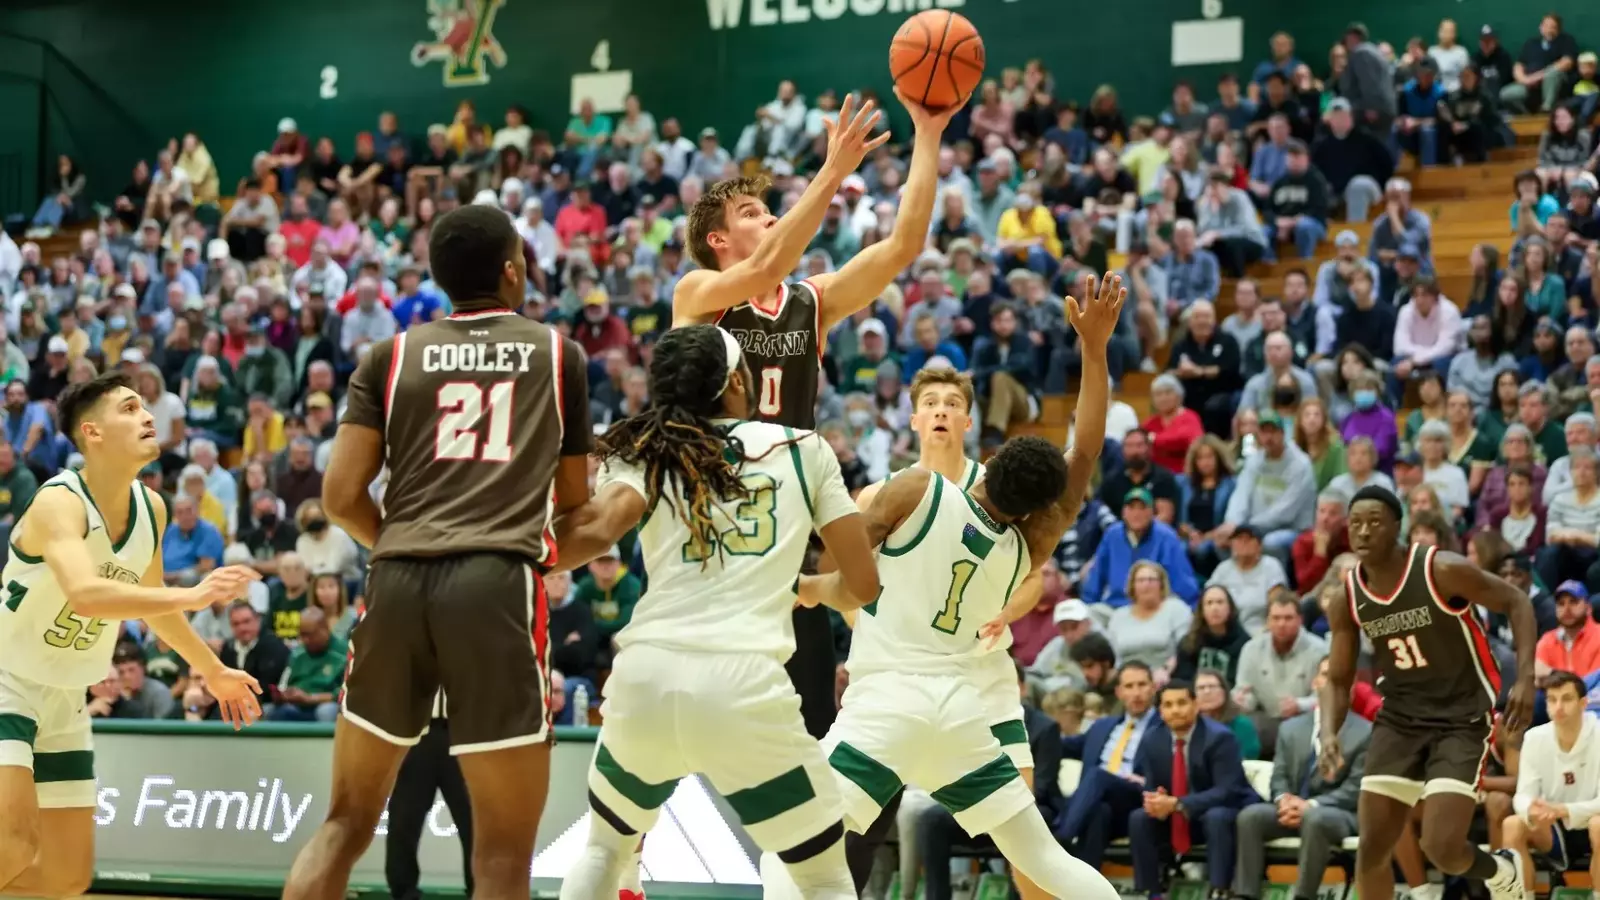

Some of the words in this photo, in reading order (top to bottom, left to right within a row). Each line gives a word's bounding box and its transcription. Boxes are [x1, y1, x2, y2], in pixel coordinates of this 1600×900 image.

[706, 0, 966, 30] WELC
[590, 39, 612, 71] 4
[320, 65, 338, 99] 2
[422, 341, 537, 373] COOLEY
[758, 366, 783, 417] 0
[433, 379, 516, 462] 21
[931, 558, 979, 635] 1
[43, 600, 108, 651] 55
[1361, 605, 1432, 640] BROWN
[1387, 634, 1429, 671] 31
[1562, 771, 1577, 786] B
[133, 776, 313, 843] Family
